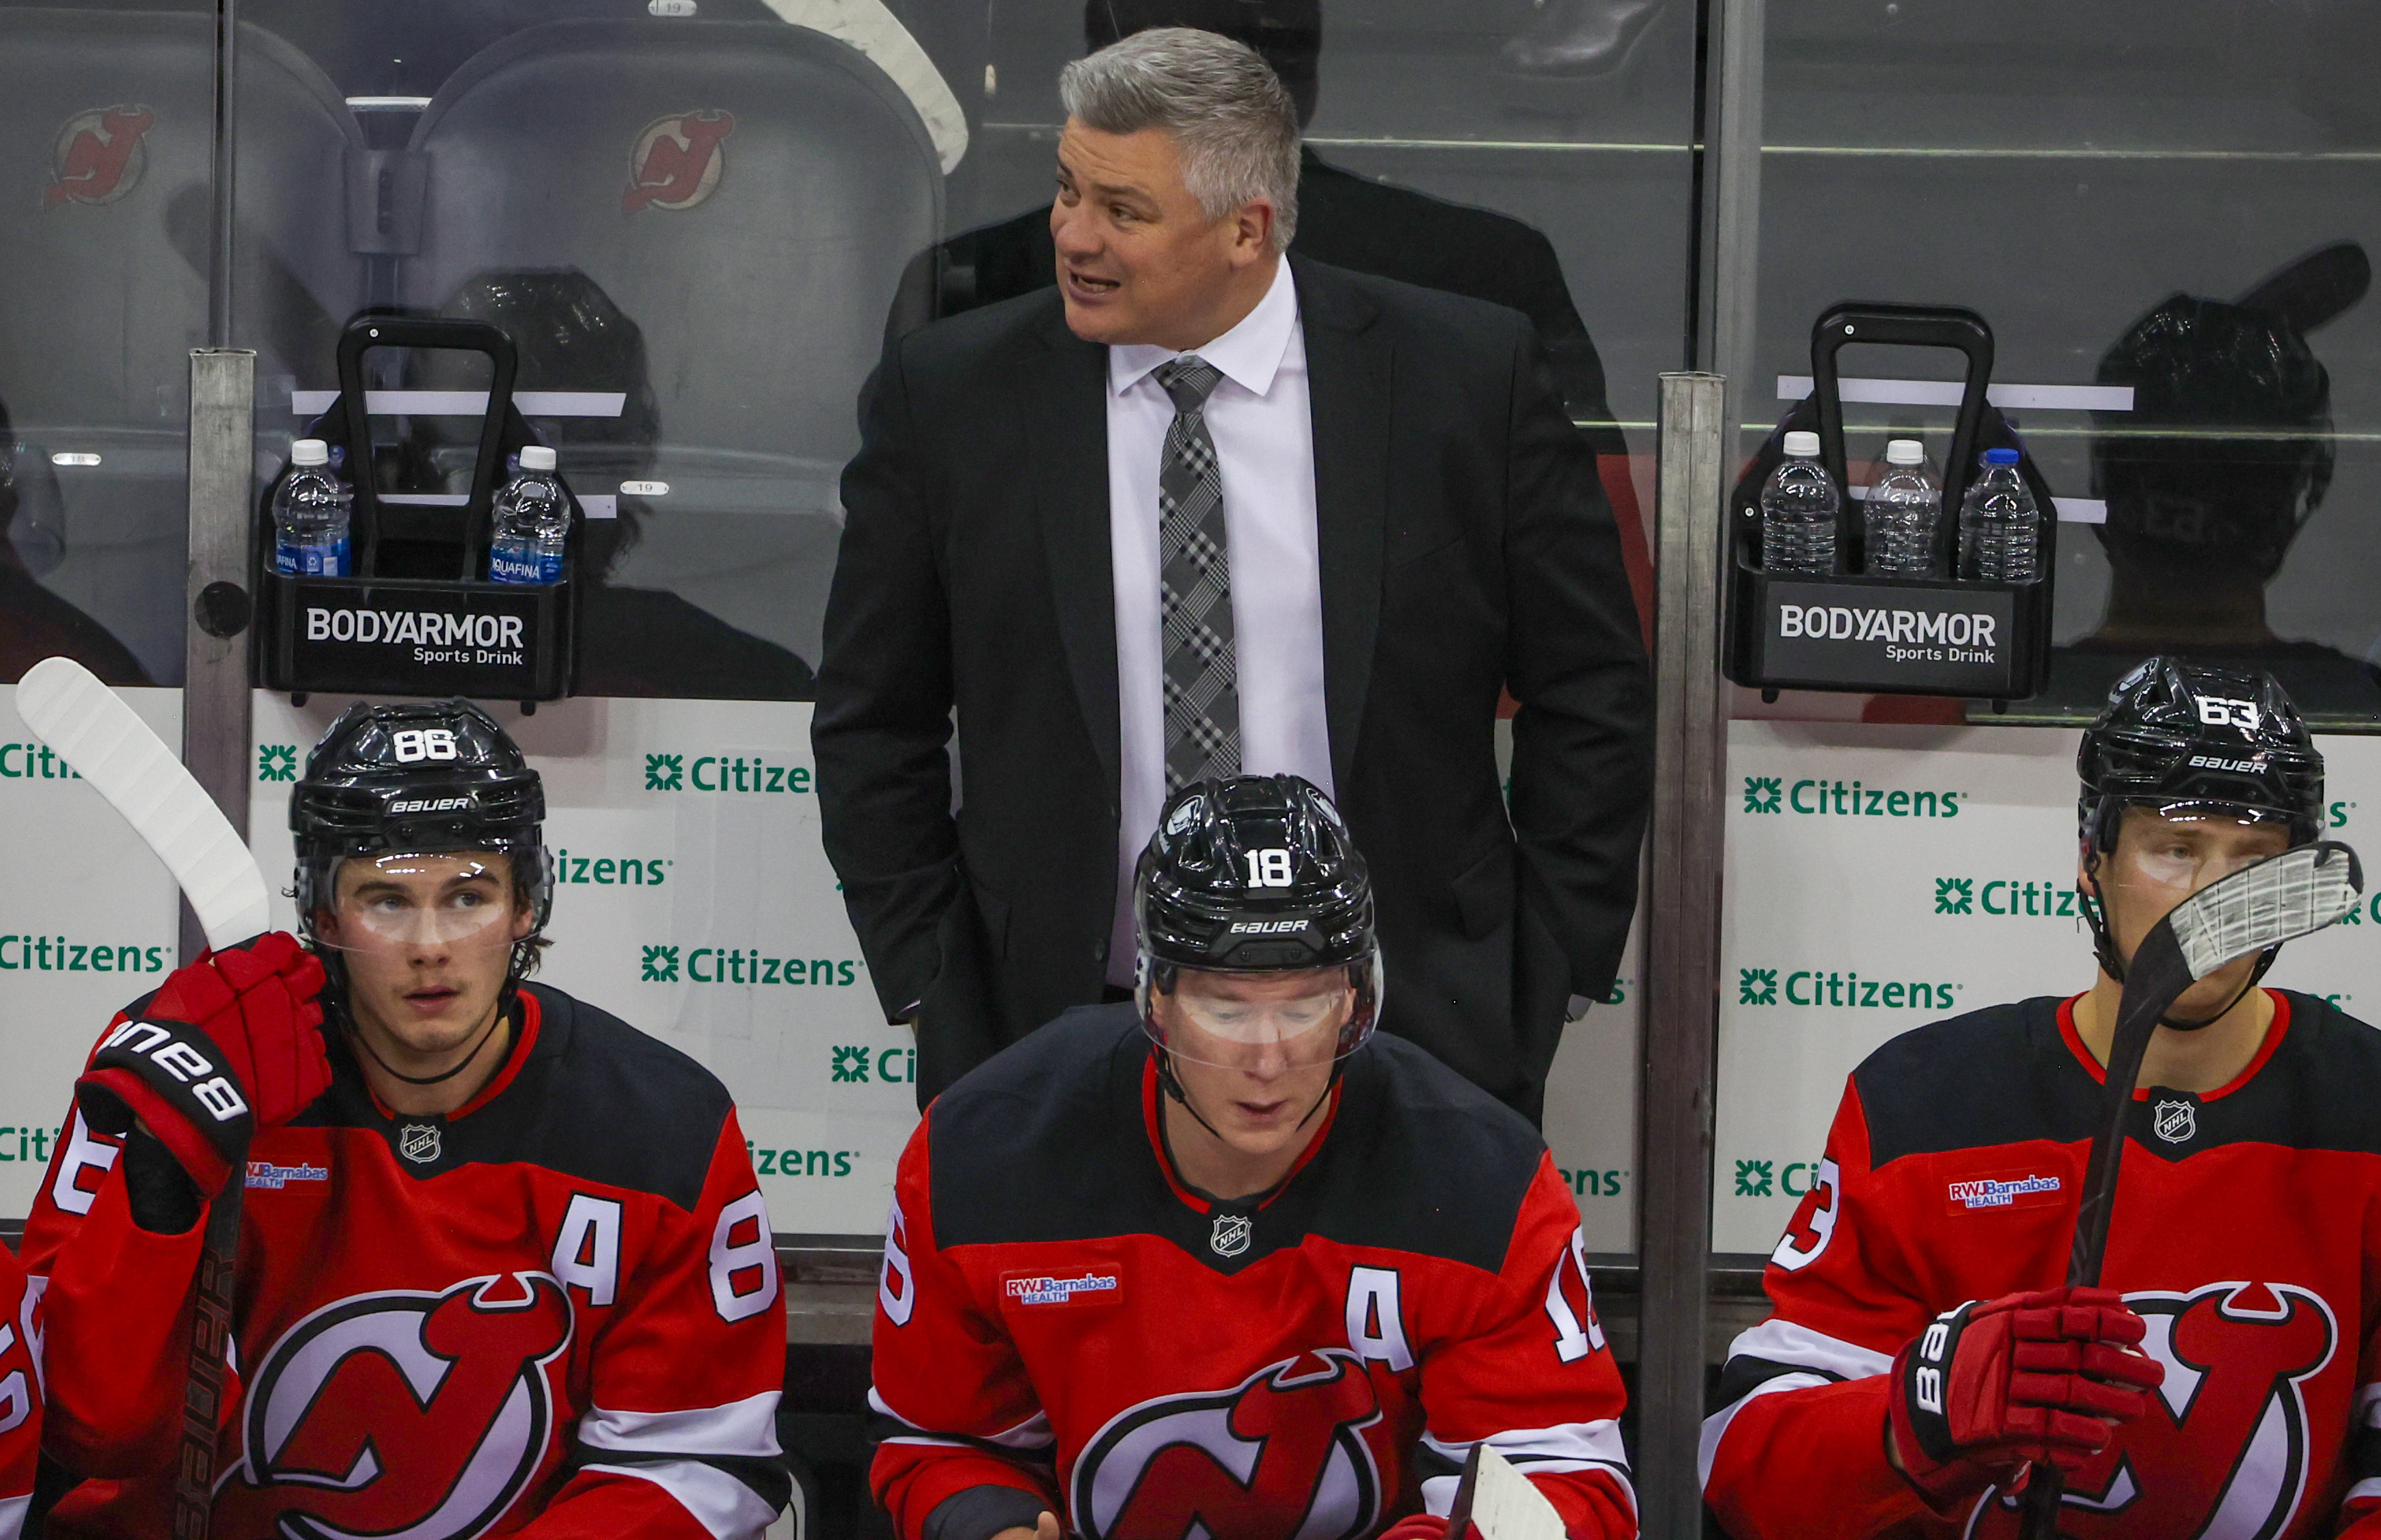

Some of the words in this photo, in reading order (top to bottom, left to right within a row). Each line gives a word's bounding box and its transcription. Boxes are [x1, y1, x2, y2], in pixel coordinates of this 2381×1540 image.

[668, 3, 681, 14] 19
[492, 558, 540, 579] AQUAFINA
[307, 607, 523, 648] BODYARMOR
[1780, 605, 1996, 647] BODYARMOR
[413, 648, 470, 665] Sports
[476, 649, 523, 665] Drink
[1886, 645, 1942, 662] Sports
[1948, 648, 1995, 663] Drink
[2197, 697, 2261, 730] 63
[393, 729, 457, 762] 86
[692, 756, 817, 793] Citize
[2189, 754, 2268, 775] BAUER
[392, 798, 469, 813] BAUER
[1790, 780, 1959, 818] Citizens
[559, 849, 664, 885] izens
[1244, 849, 1294, 888] 18
[1230, 920, 1309, 935] BAUER
[0, 935, 163, 972] Citizens
[688, 948, 855, 986] Citizens
[1785, 972, 1955, 1009] Citizens
[2164, 1112, 2187, 1133] NHL
[410, 1136, 433, 1153] NHL
[746, 1140, 852, 1177] izens
[1966, 1194, 2011, 1207] HEALTH
[552, 1193, 623, 1306] A
[1219, 1227, 1243, 1248] NHL
[1022, 1291, 1067, 1304] HEALTH
[1346, 1265, 1414, 1372] A
